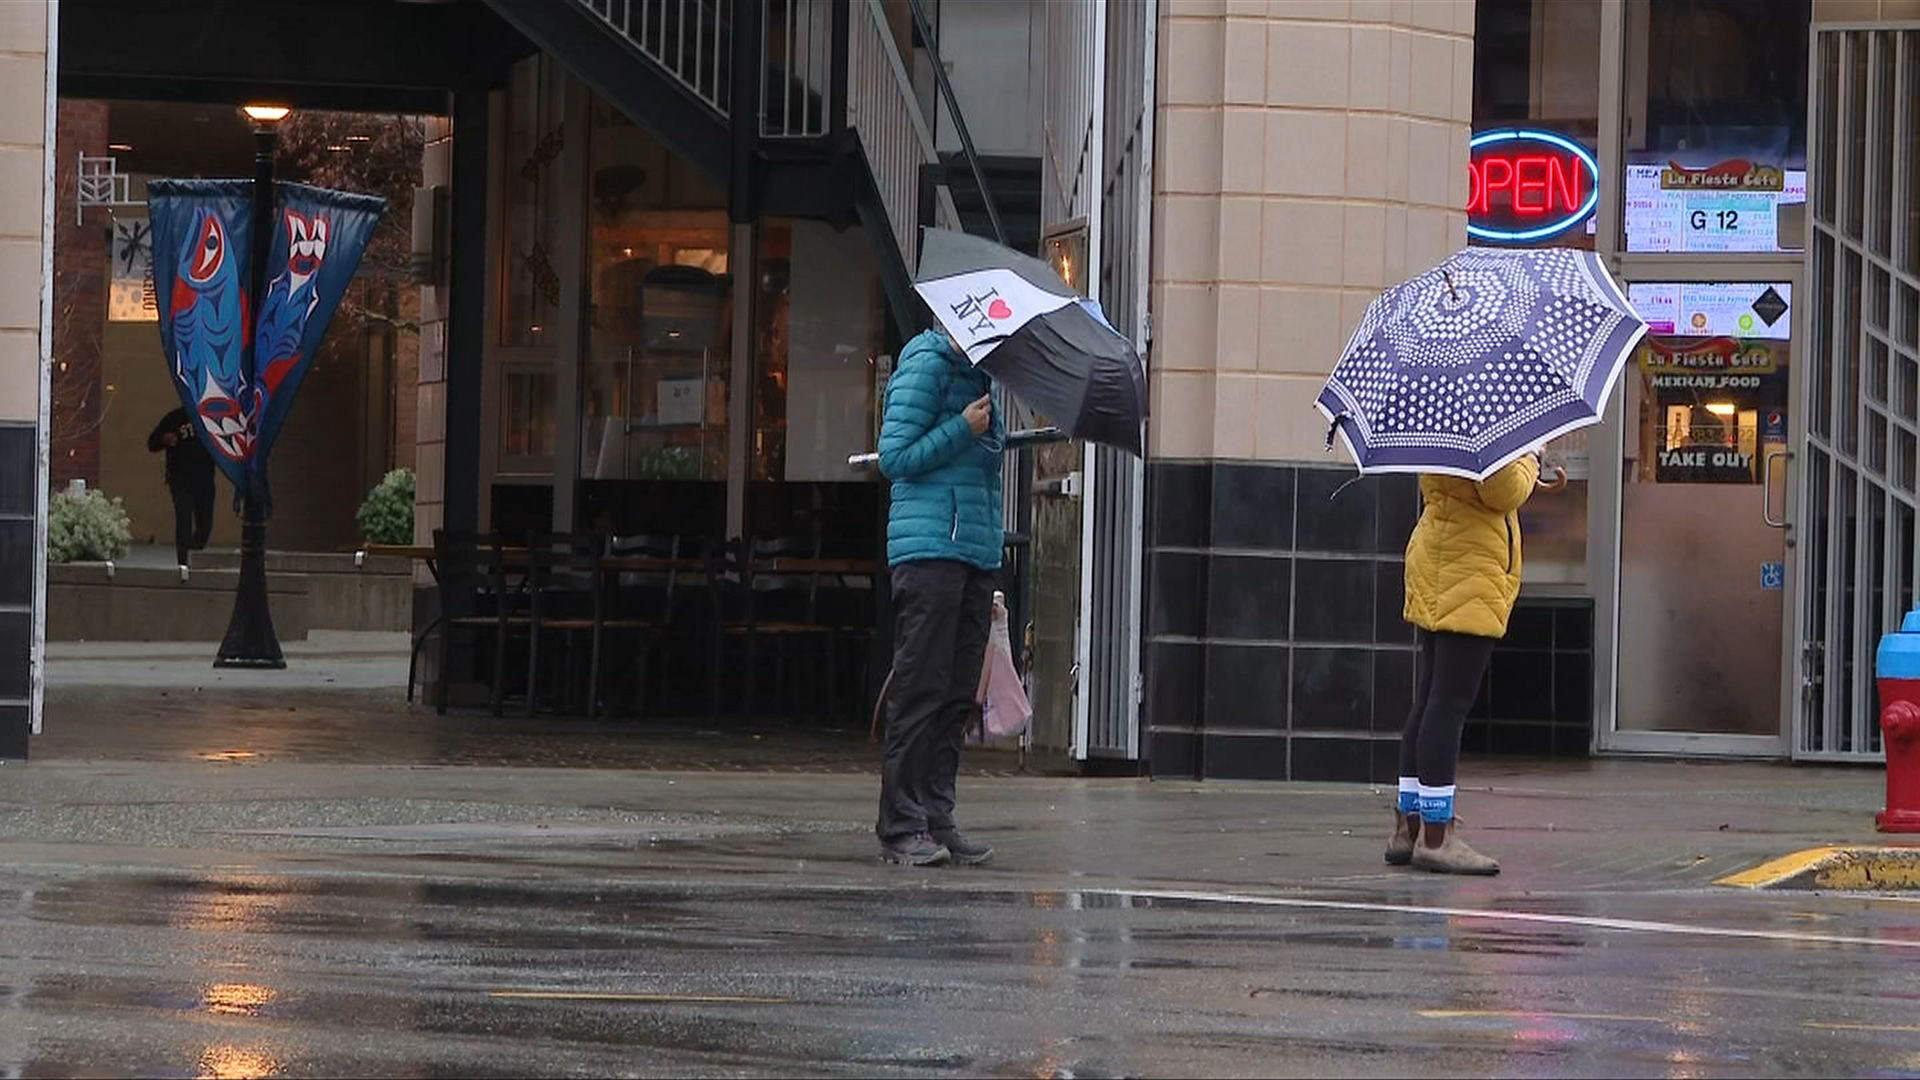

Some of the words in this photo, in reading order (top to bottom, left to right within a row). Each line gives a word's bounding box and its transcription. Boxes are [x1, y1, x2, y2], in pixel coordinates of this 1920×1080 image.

[1668, 173, 1686, 185] La
[1690, 173, 1739, 185] Fiesta
[1690, 210, 1706, 230] G
[1716, 210, 1739, 230] 12
[950, 294, 996, 336] NY
[1647, 351, 1665, 366] La
[1672, 351, 1724, 367] Fiesta
[1651, 376, 1716, 388] MEXICAN
[1717, 376, 1761, 389] FOOD
[1659, 452, 1707, 467] TAKE
[1711, 452, 1752, 468] OUT
